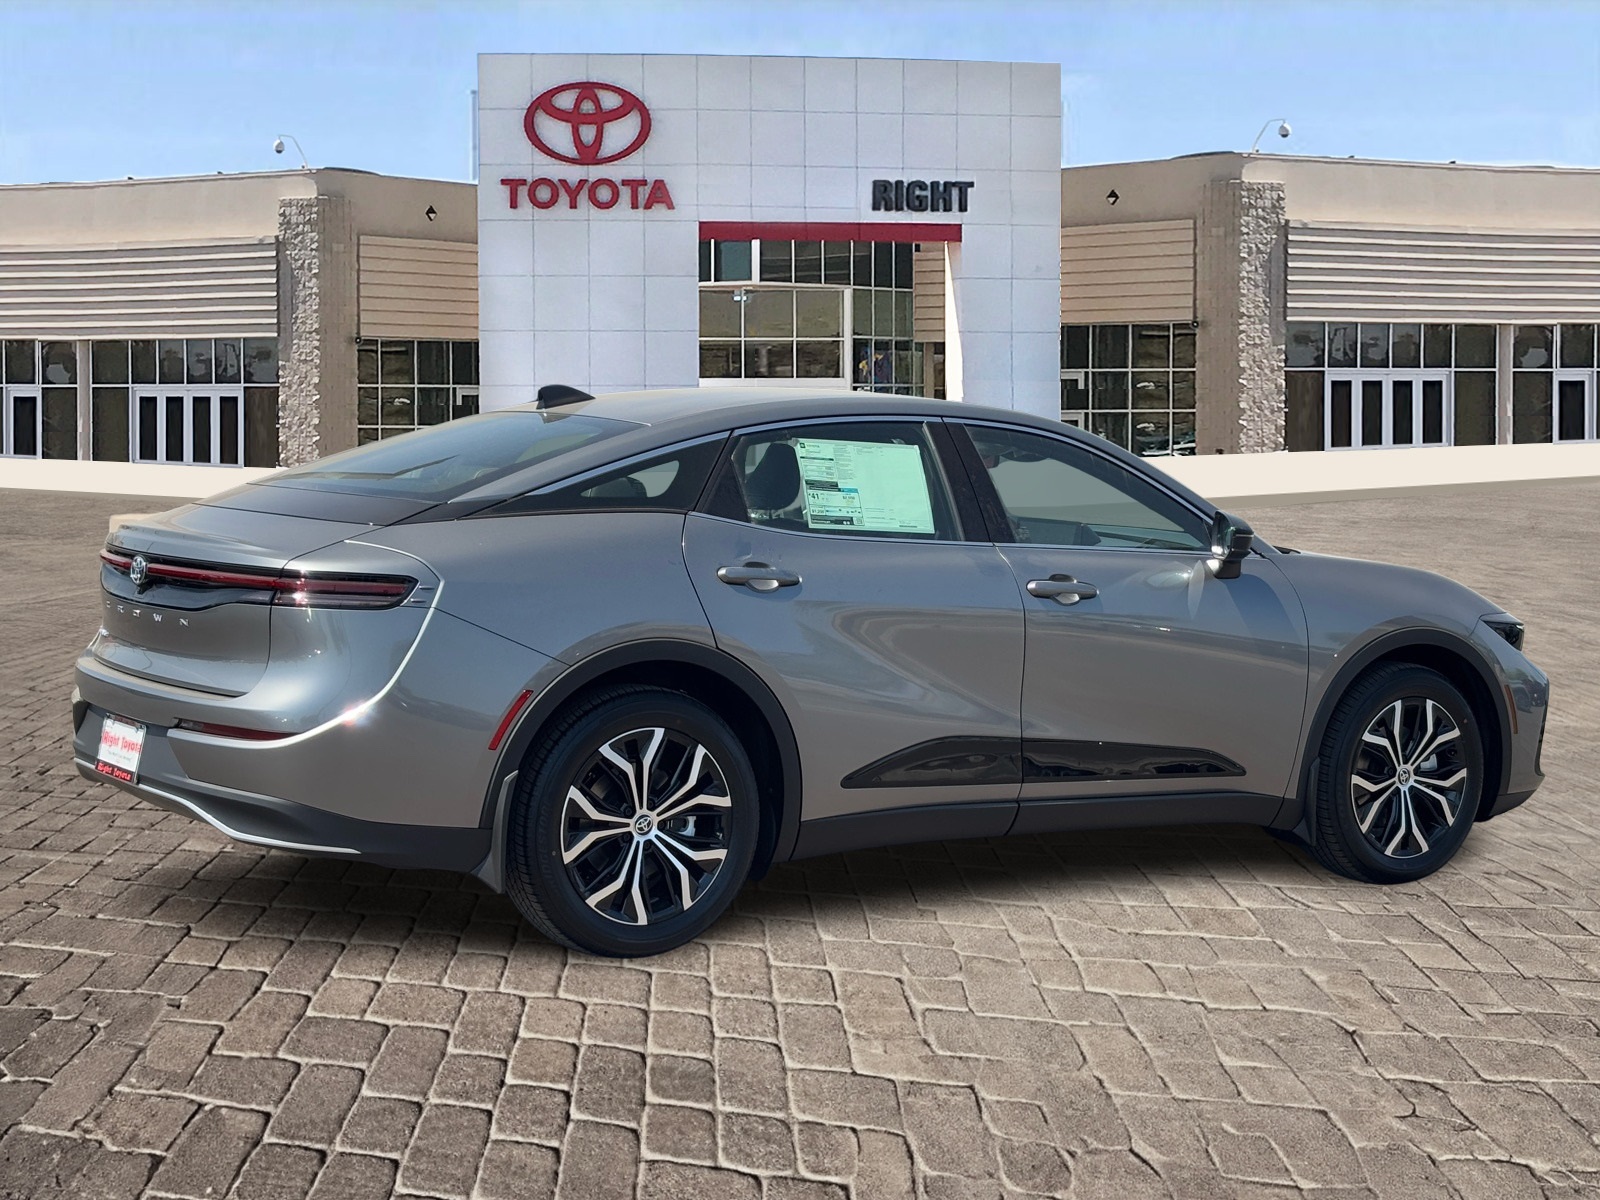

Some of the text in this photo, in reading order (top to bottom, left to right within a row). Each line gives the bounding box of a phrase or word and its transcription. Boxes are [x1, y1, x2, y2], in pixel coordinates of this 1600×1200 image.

[500, 178, 676, 210] TOYOTA
[871, 180, 976, 212] RIGHT
[103, 731, 119, 747] Right
